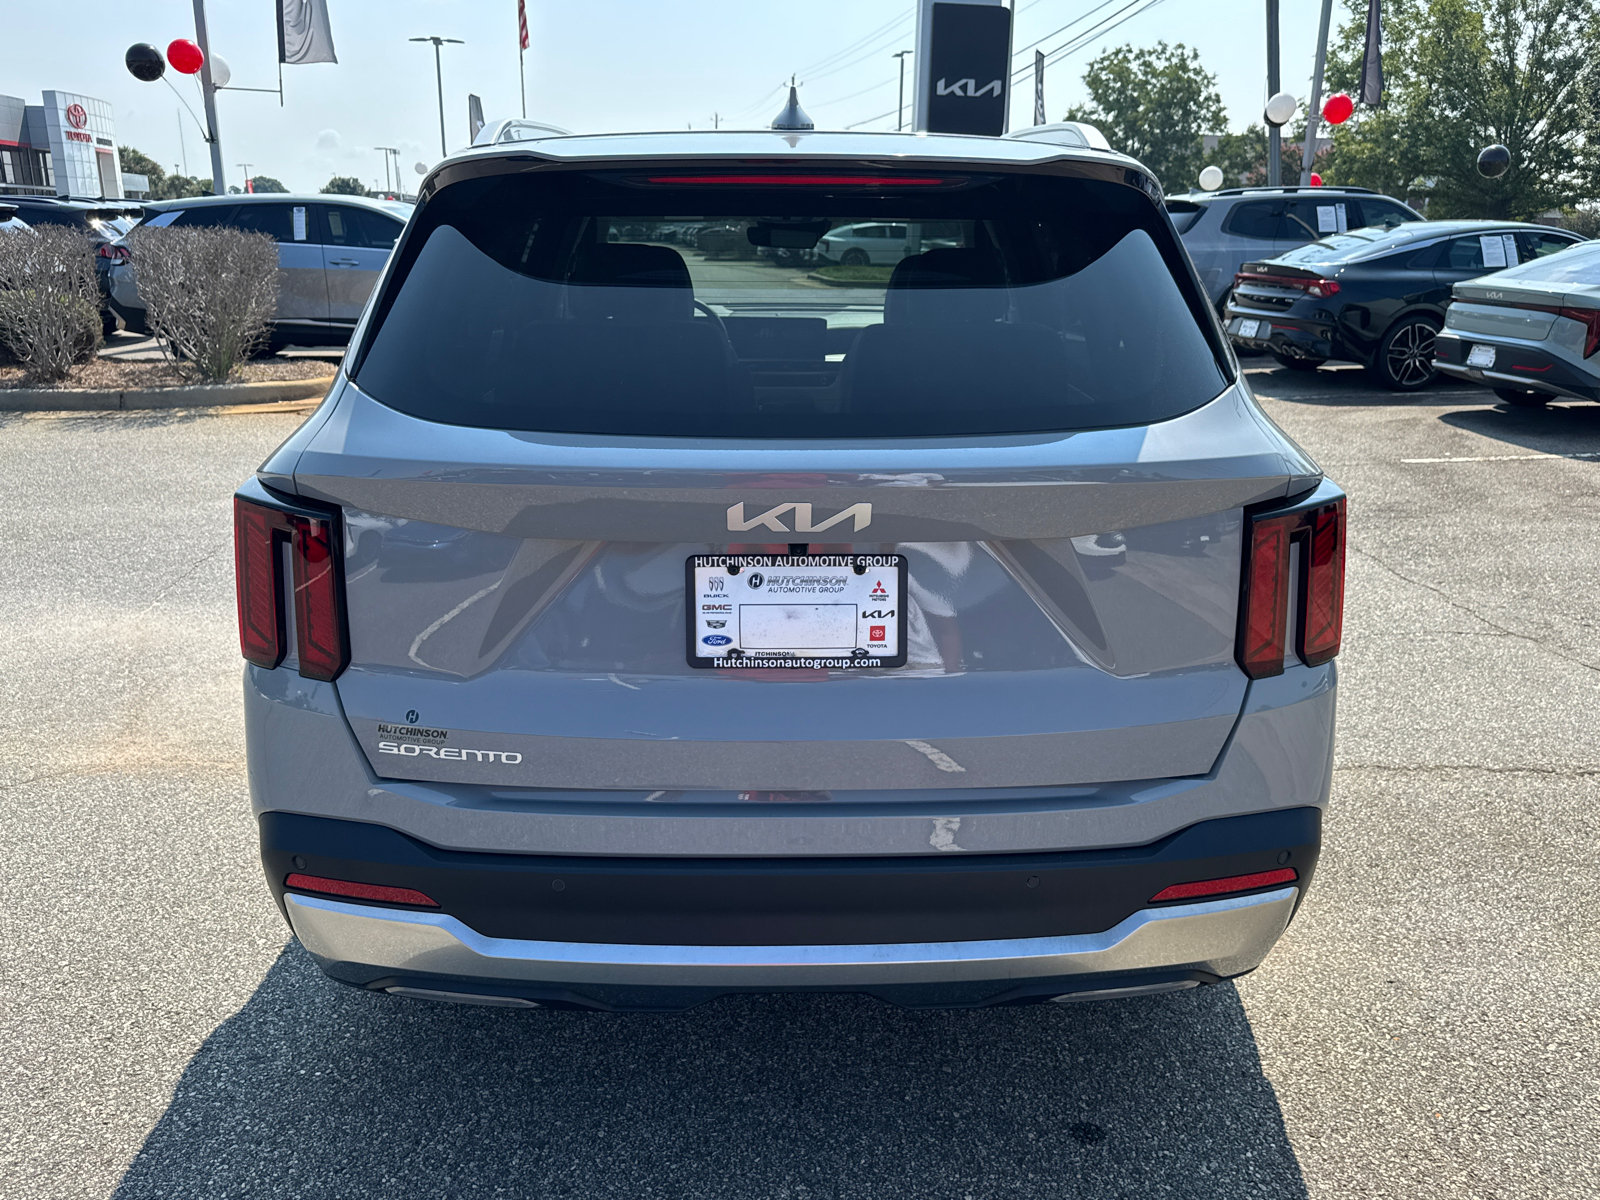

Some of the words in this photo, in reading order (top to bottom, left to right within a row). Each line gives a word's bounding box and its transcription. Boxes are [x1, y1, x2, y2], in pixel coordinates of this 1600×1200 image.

[936, 78, 1002, 98] KIA
[726, 501, 873, 533] KIA
[694, 556, 772, 568] HUTCHINSON
[775, 556, 854, 568] AUTOMOTIVE
[856, 556, 899, 568] GROUP
[818, 586, 845, 594] GROUP
[861, 609, 896, 619] KIA
[707, 636, 727, 645] Ford
[713, 657, 881, 669] Hutchinsonautogroup.com
[377, 724, 449, 739] HUTCHINSON
[379, 734, 421, 744] AUTOMOTIVE
[422, 737, 446, 746] GROUP
[378, 741, 523, 764] SORENTO
